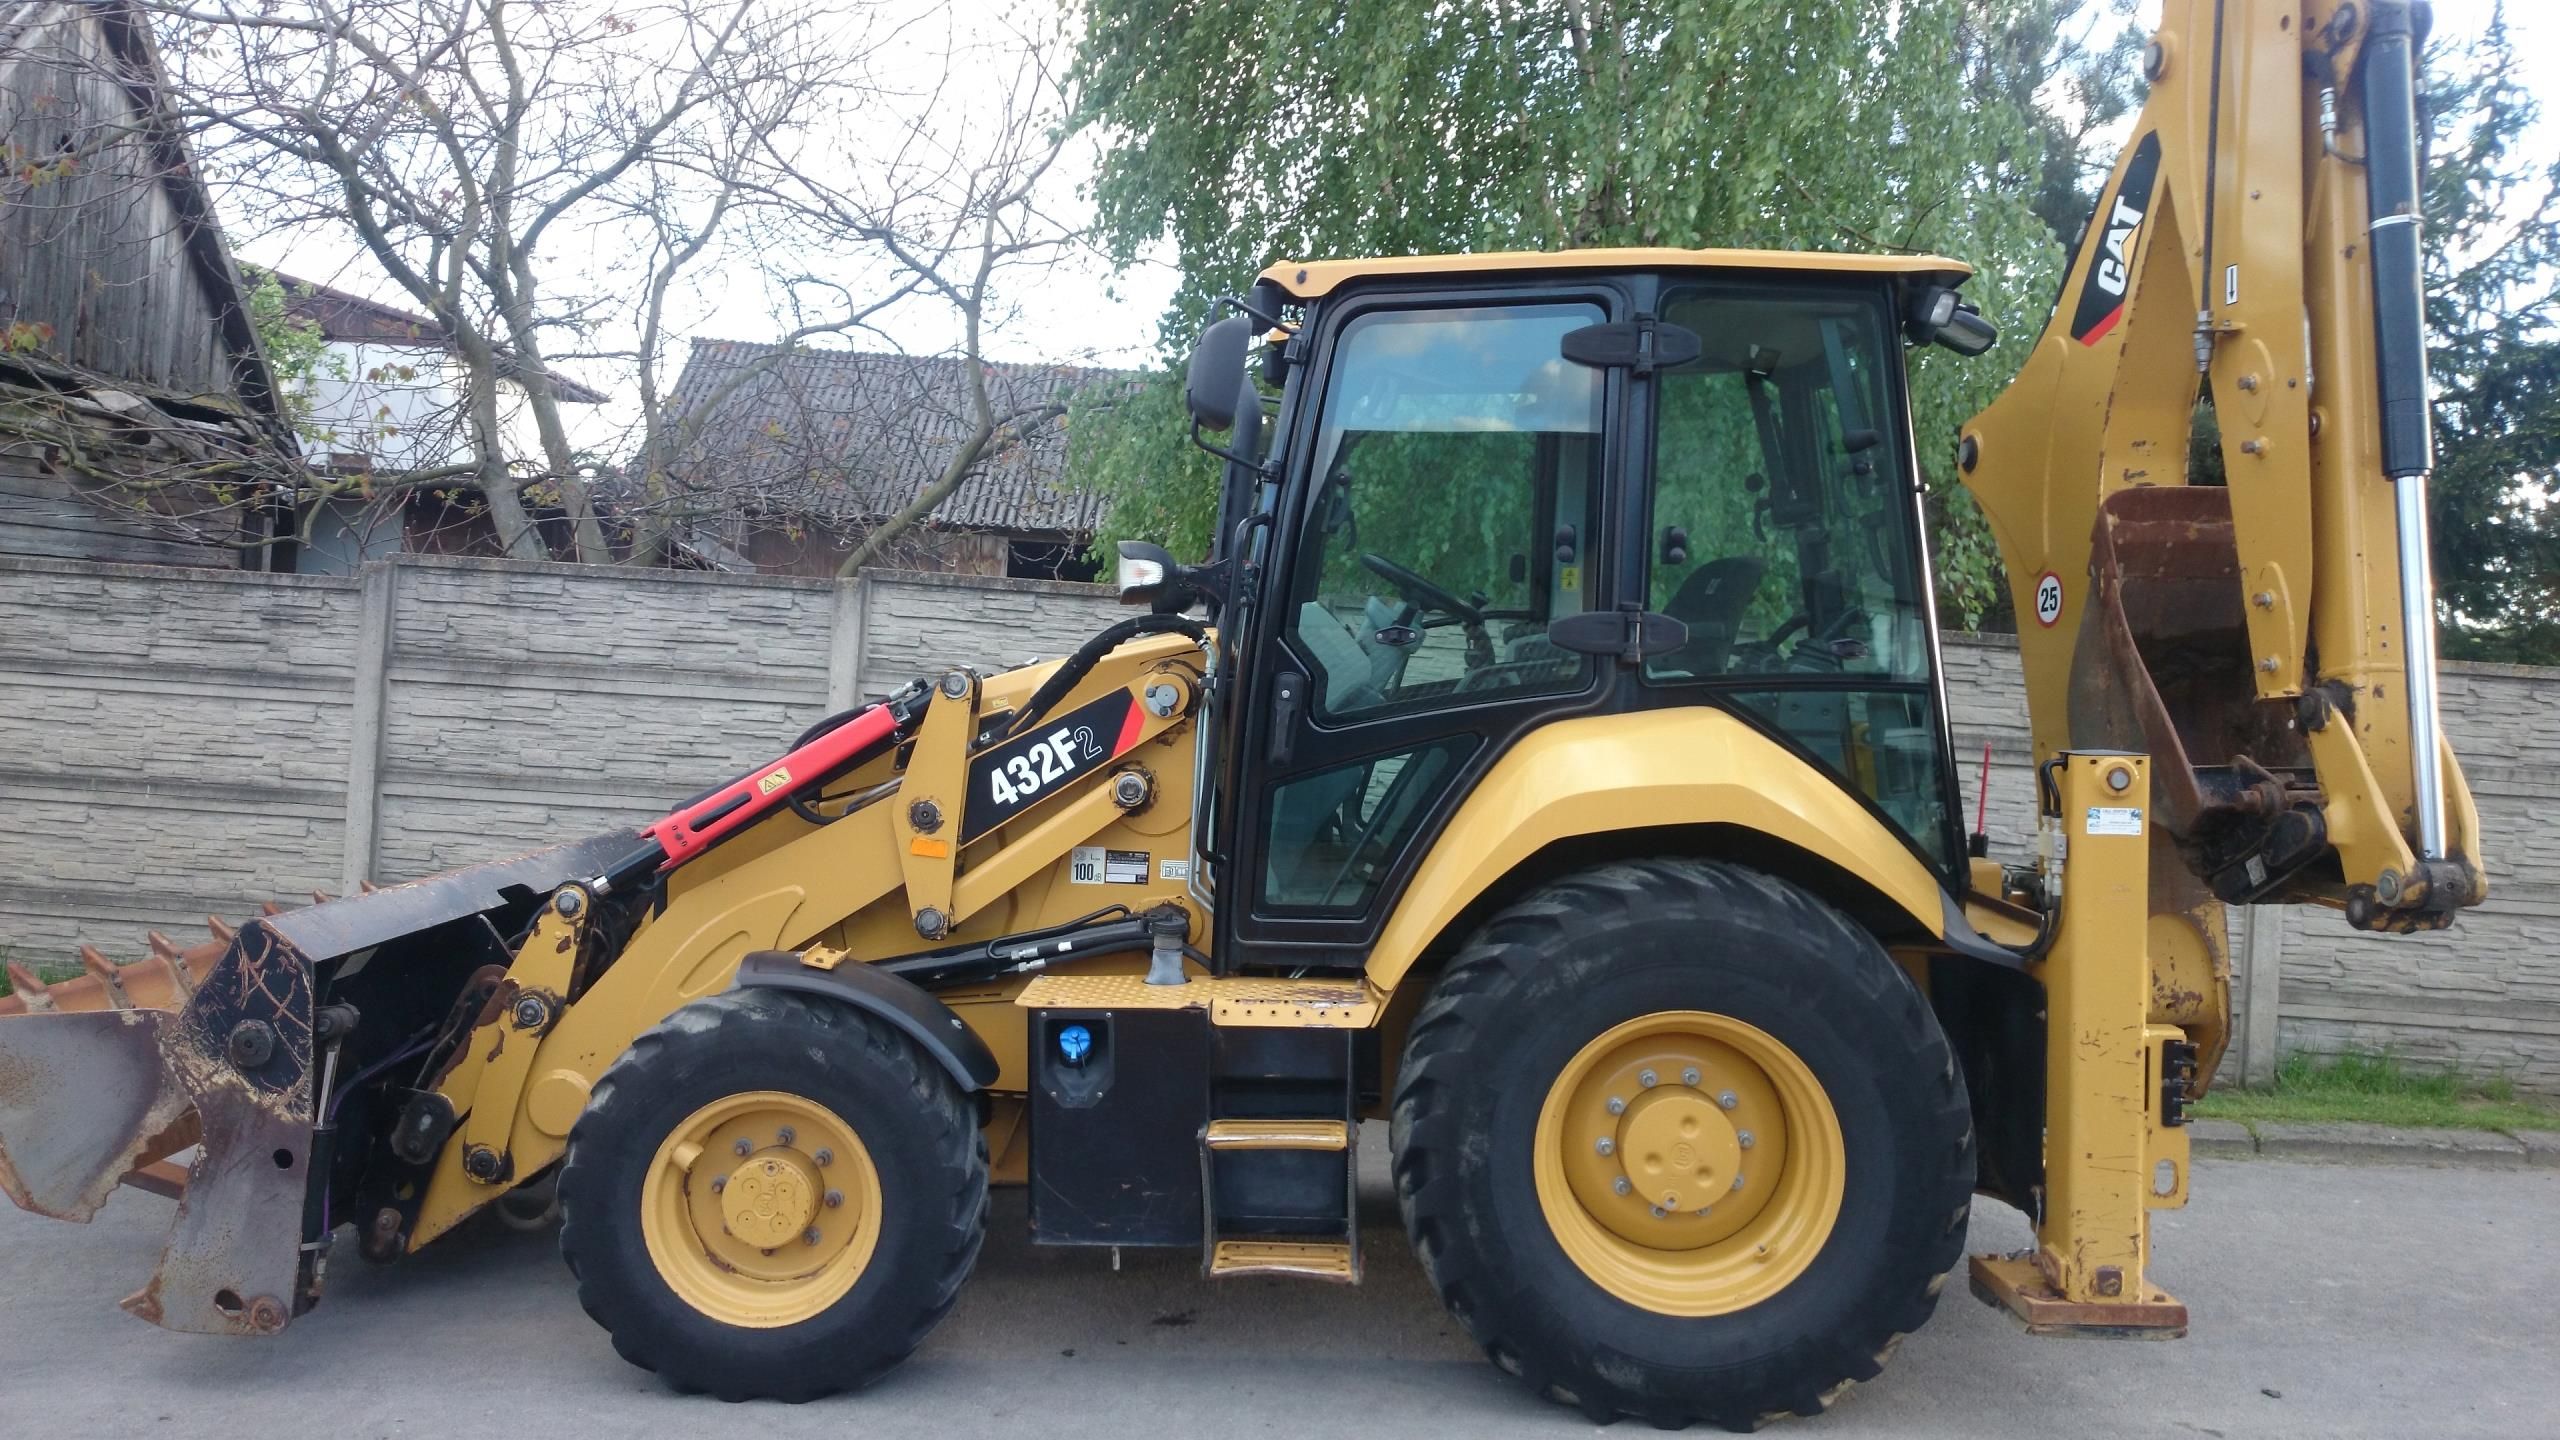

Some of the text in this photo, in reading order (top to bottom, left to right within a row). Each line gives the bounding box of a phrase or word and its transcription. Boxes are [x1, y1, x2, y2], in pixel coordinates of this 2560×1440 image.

[2098, 195, 2144, 296] CAT
[2040, 586, 2058, 612] 25
[991, 726, 1103, 805] 432F2
[1074, 863, 1102, 882] 100 dB
